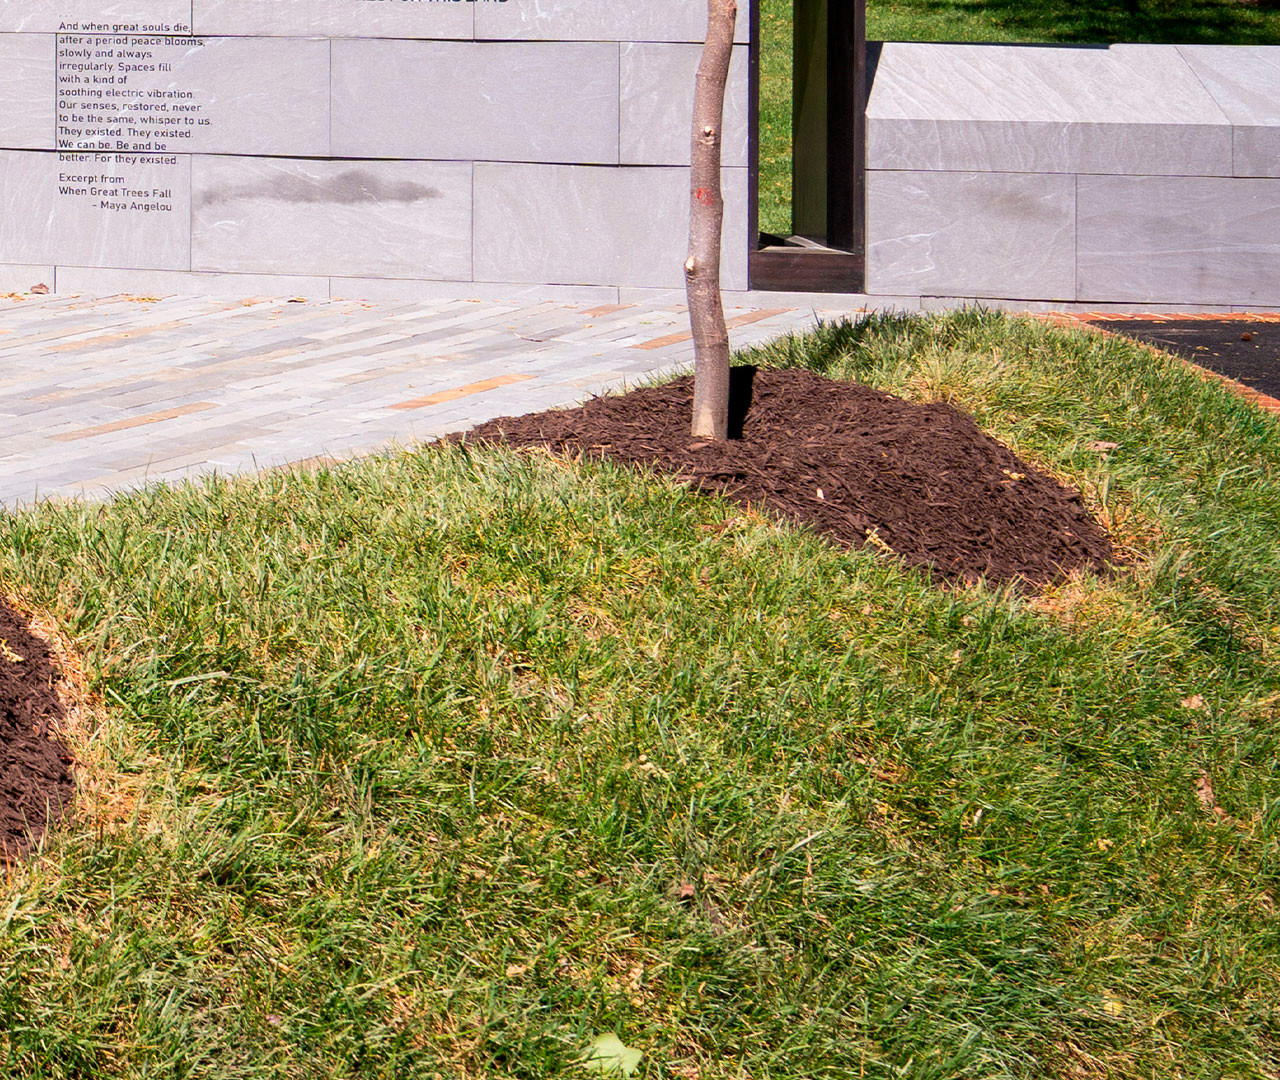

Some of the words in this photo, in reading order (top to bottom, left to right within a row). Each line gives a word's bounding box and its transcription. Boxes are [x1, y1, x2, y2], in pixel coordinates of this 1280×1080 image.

[59, 22, 78, 30] And
[82, 23, 109, 31] when
[113, 24, 138, 33] great
[174, 24, 191, 33] die,
[60, 36, 83, 44] after
[96, 36, 127, 46] period
[132, 38, 161, 46] peace
[165, 37, 205, 47] blooms,
[60, 50, 91, 59] slowly
[117, 50, 152, 59] always
[60, 63, 114, 72] irregularly.
[118, 63, 154, 72] Spaces
[158, 63, 171, 71] fill
[118, 76, 127, 84] of
[60, 89, 102, 98] soothing
[147, 90, 195, 98] vibration.
[60, 101, 77, 109] Our
[81, 102, 119, 110] senses,
[123, 102, 169, 111] restored,
[87, 115, 103, 123] the
[107, 116, 136, 124] same,
[140, 117, 181, 126] whisper
[185, 117, 194, 125] to
[60, 127, 82, 137] They
[86, 128, 123, 136] existed.
[127, 128, 151, 138] They
[154, 130, 193, 138] existed.
[59, 140, 73, 148] We
[98, 141, 112, 149] be.
[117, 141, 129, 149] Be
[133, 142, 150, 150] and
[155, 142, 166, 150] be
[60, 154, 91, 162] better.
[115, 155, 136, 165] they
[60, 173, 97, 184] Excerpt
[101, 174, 124, 183] from
[59, 186, 86, 195] When
[90, 188, 118, 196] Great
[122, 188, 149, 197] Trees
[153, 189, 171, 198] Fall
[101, 201, 126, 210] Maya
[131, 202, 172, 212] Angelou
